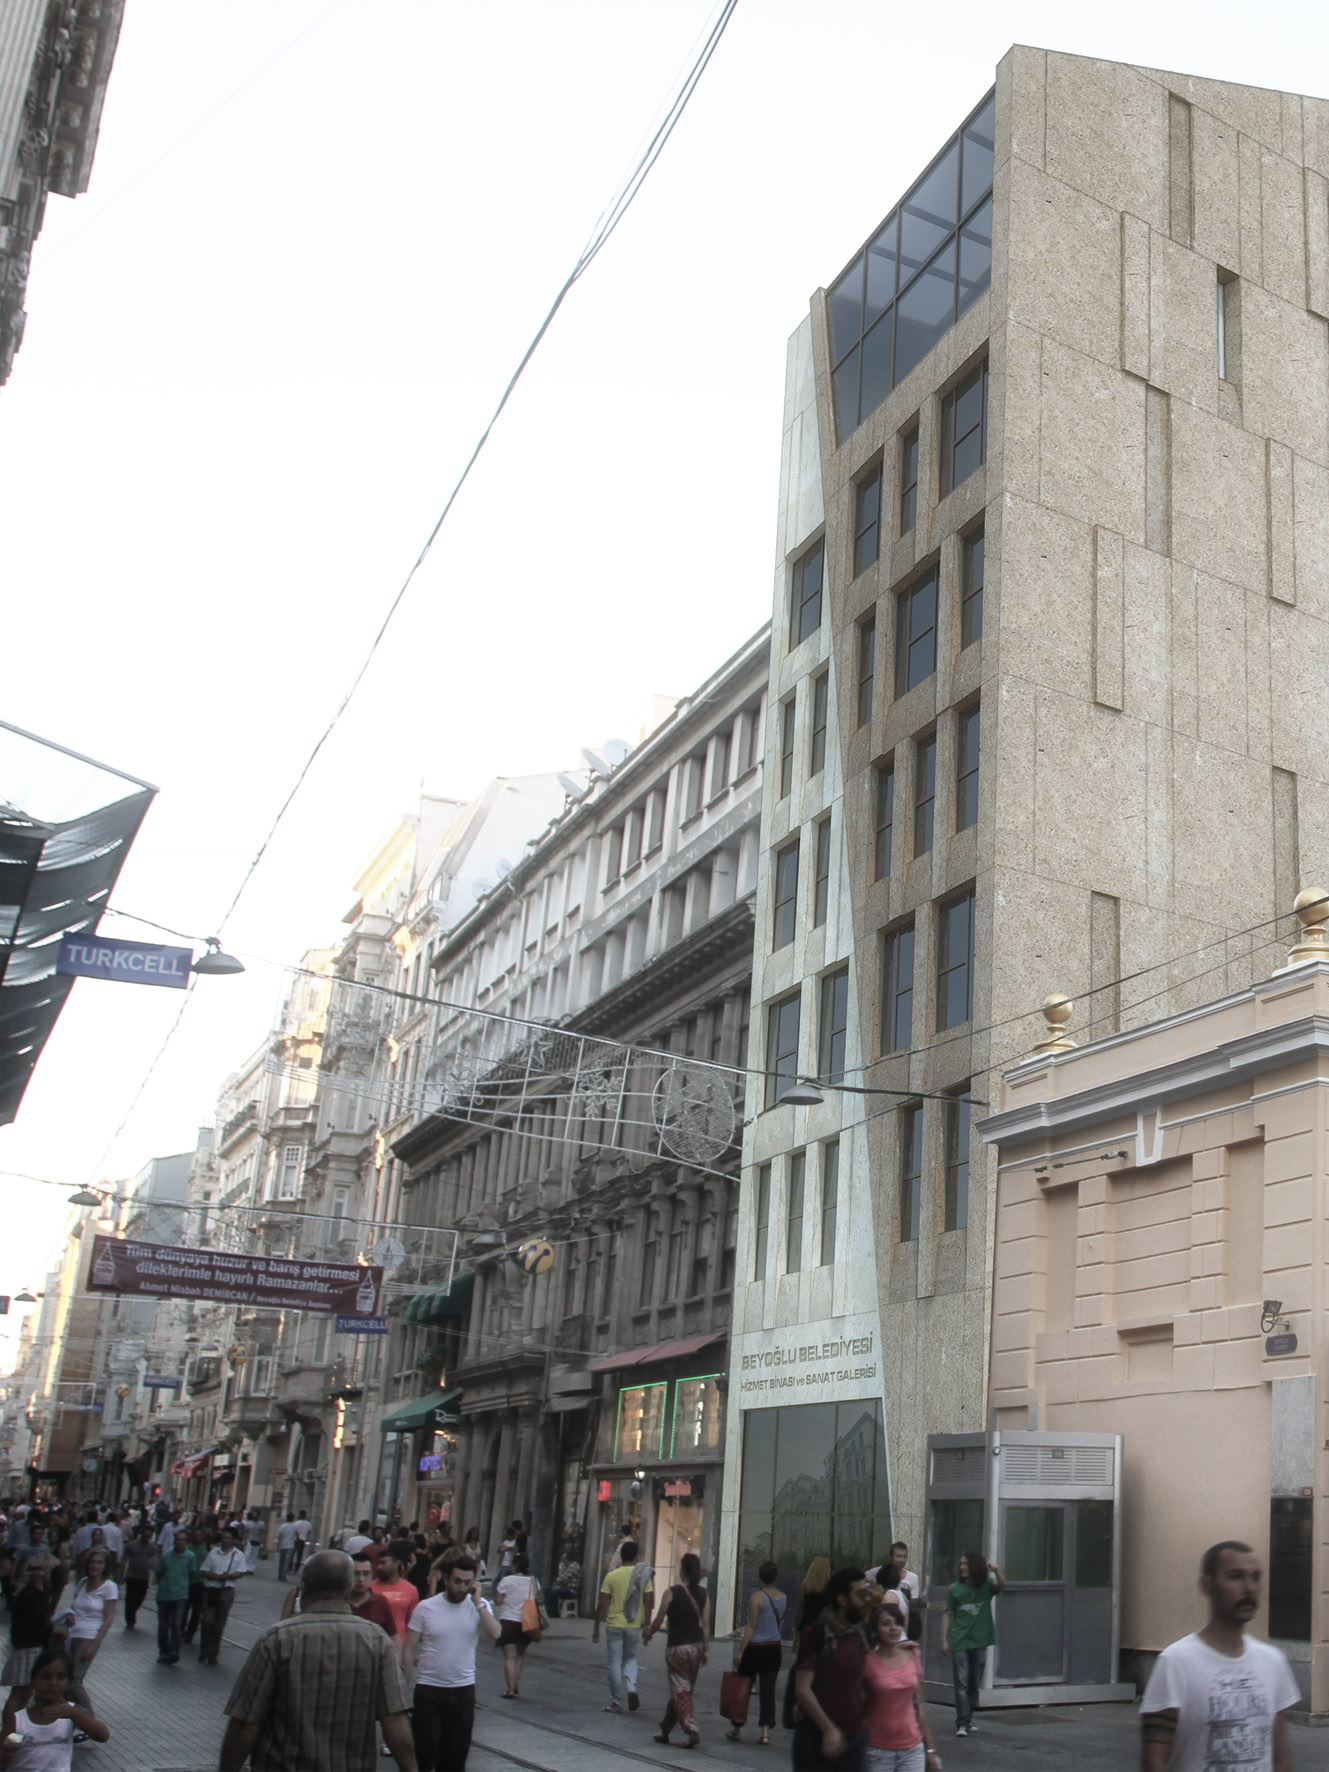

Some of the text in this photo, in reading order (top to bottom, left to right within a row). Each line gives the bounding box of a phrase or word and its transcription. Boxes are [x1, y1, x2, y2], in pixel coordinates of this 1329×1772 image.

[67, 944, 183, 976] TURKCELL
[126, 1245, 360, 1281] Tüm dünyaya huzur ve barış getirmesi
[136, 1261, 344, 1294] dileklerimle hayırlı Ramazanlar...
[139, 1281, 169, 1293] Ahmet
[203, 1287, 248, 1300] DEMİRCAN
[339, 1319, 386, 1329] TURKCELL
[742, 1331, 873, 1370] BEYOĞLU BELEDİYESİ
[741, 1362, 877, 1392] HİZMET BİNASI ve SANAT GALERİSİ
